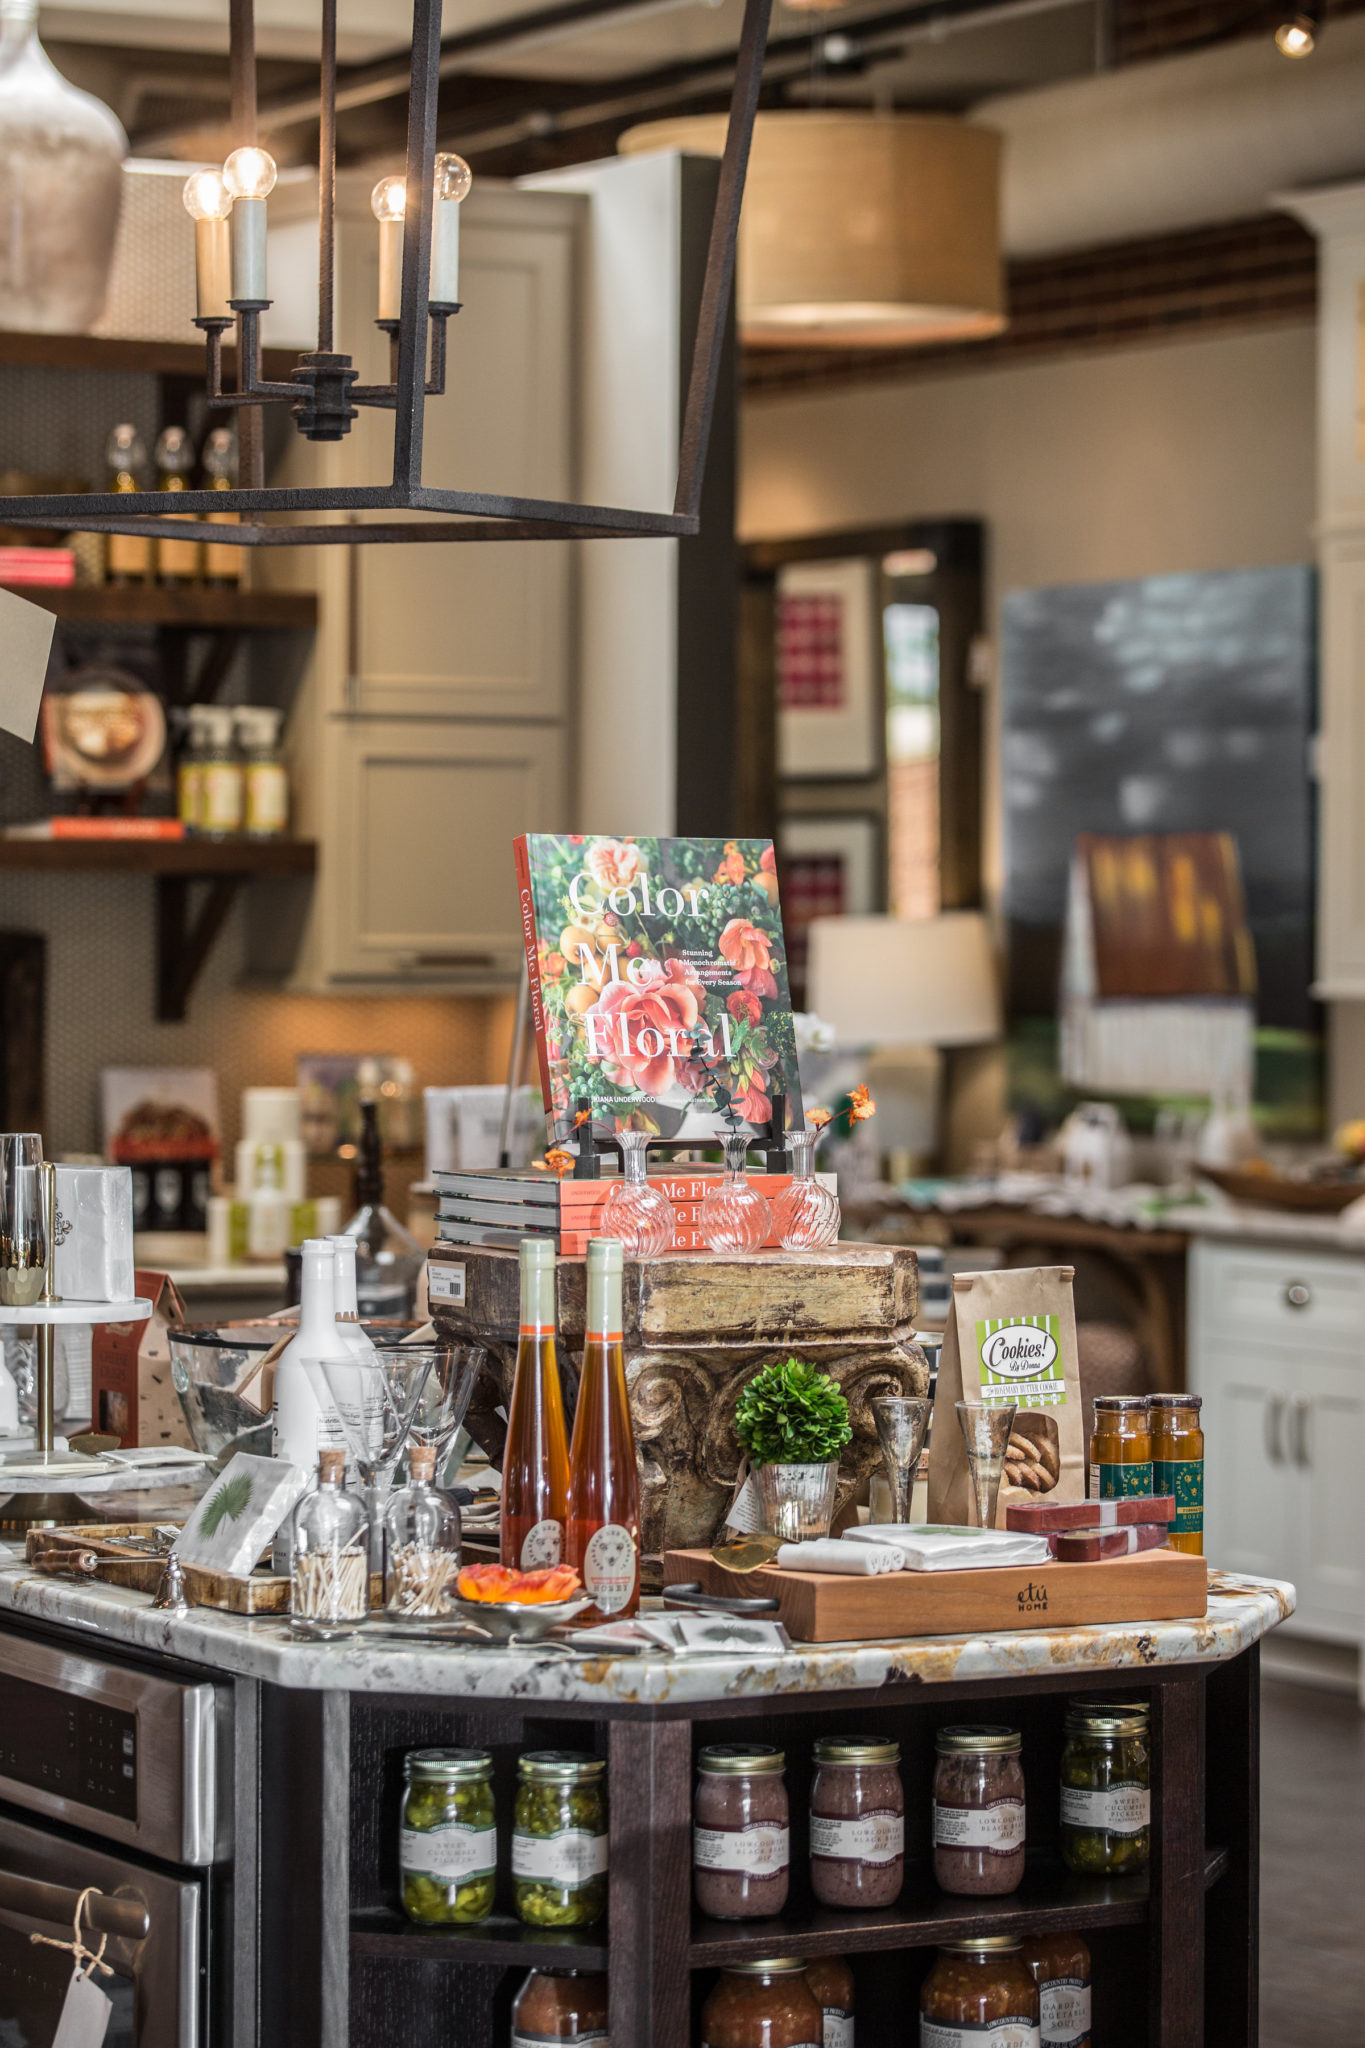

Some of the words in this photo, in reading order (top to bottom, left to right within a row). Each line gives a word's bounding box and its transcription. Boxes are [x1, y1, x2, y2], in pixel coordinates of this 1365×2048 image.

[569, 871, 710, 917] Color
[520, 888, 533, 940] Color
[526, 944, 537, 973] Me
[682, 949, 713, 958] Stunning
[573, 942, 654, 987] Me
[684, 969, 732, 977] Arrangements
[696, 979, 717, 987] Every
[530, 976, 544, 1031] Floral
[580, 1011, 737, 1058] Floral
[661, 1182, 686, 1198] Me
[988, 1335, 1048, 1367] Cookies!
[1009, 1360, 1020, 1372] By
[1020, 1359, 1041, 1371] Donna
[1018, 1602, 1048, 1612] HOME
[1042, 2008, 1086, 2020] EGETABLE
[824, 2031, 842, 2040] DEN
